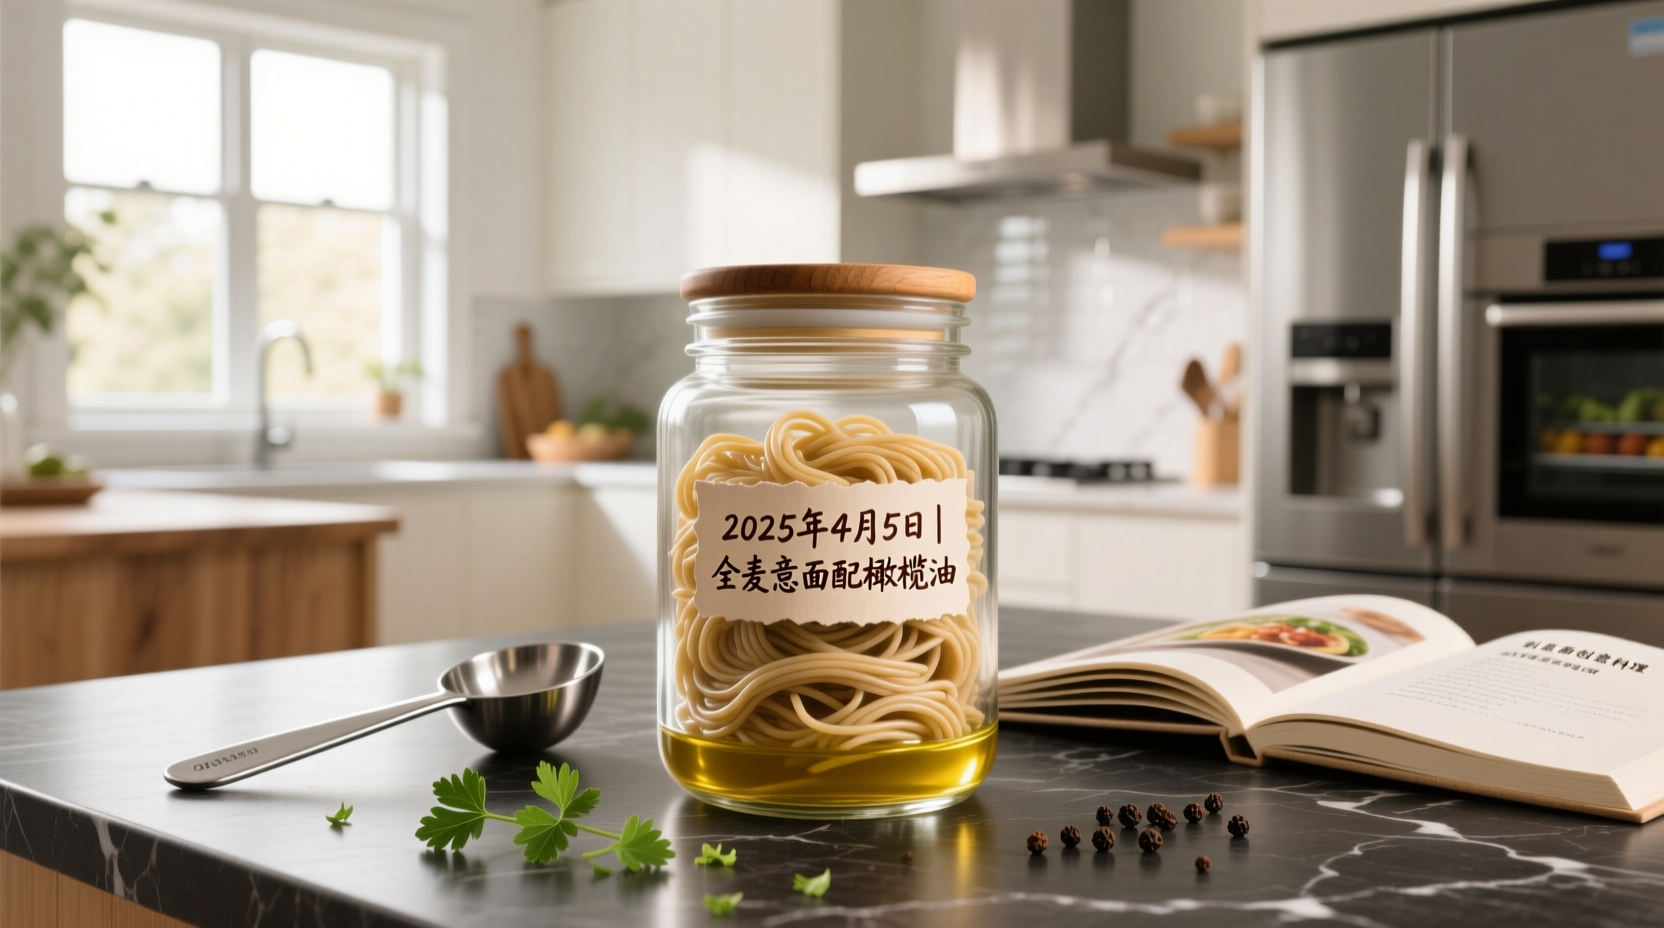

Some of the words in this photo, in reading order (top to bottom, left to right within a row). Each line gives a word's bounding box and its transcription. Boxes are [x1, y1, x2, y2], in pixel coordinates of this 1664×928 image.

[721, 508, 922, 549] 2025年4月5日
[711, 553, 957, 594] 全麦意面配橄榄油
